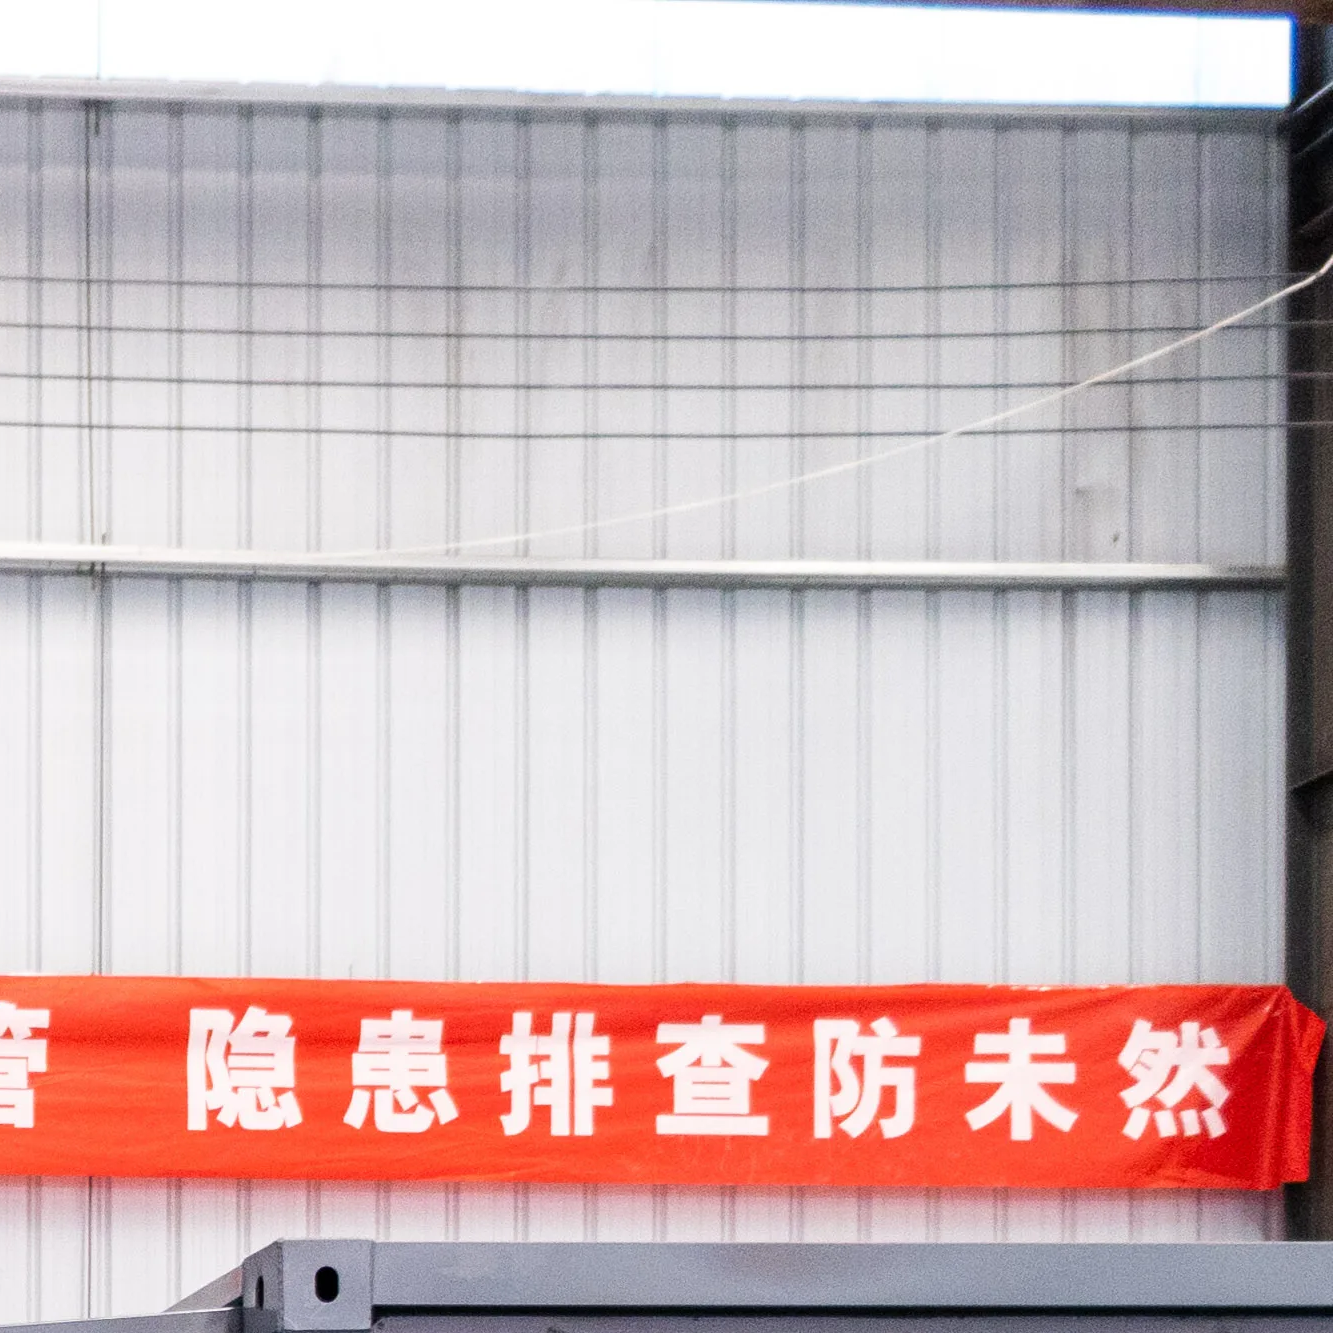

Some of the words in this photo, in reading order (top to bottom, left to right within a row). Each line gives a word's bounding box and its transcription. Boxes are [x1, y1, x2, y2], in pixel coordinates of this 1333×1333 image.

[185, 1004, 1231, 1142] 隐患排查防未然
